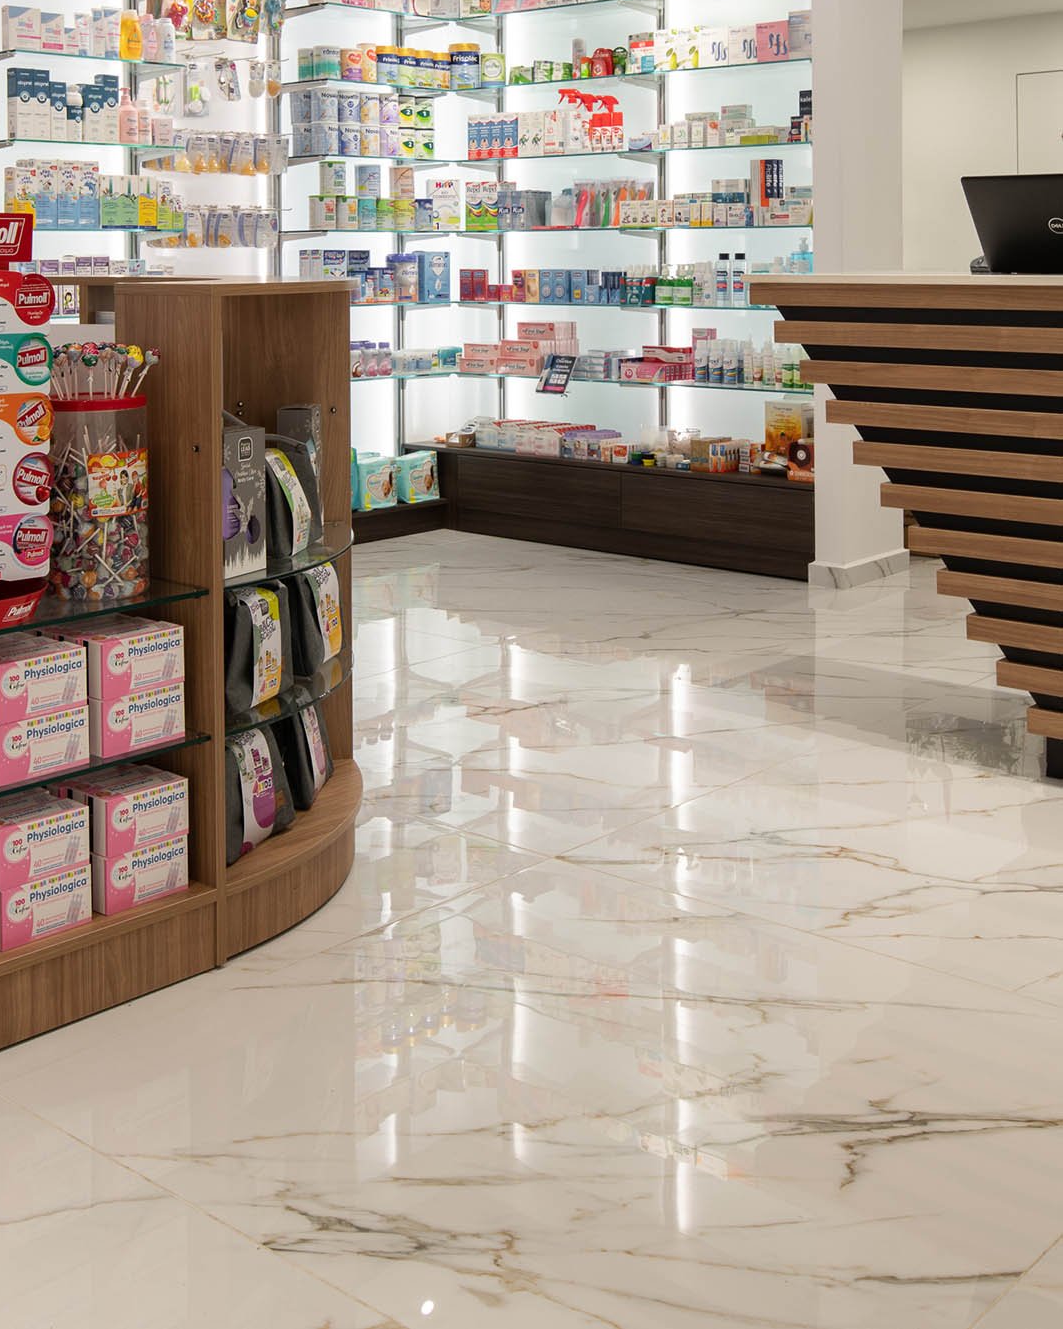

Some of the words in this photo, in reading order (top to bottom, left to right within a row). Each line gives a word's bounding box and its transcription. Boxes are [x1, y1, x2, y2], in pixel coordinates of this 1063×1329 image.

[18, 292, 48, 305] Pulmoll
[17, 349, 45, 365] Pulmoll
[18, 470, 46, 485] Pulmoll
[17, 530, 46, 542] Pulmoll
[7, 601, 36, 618] Pulmoll
[128, 637, 180, 658] Physiologica
[114, 652, 125, 660] 100
[24, 659, 82, 680] Physiologica
[8, 675, 20, 683] 100
[128, 693, 181, 714] Physiologica
[115, 709, 125, 717] 100
[26, 717, 84, 739] Physiologica
[11, 735, 22, 743] 100
[132, 790, 185, 812] Physiologica
[118, 808, 129, 816] 100
[26, 819, 85, 842] Physiologica
[12, 838, 23, 847] 100
[131, 846, 184, 869] Physiologica
[29, 877, 87, 902] Physiologica
[14, 898, 26, 907] 100
